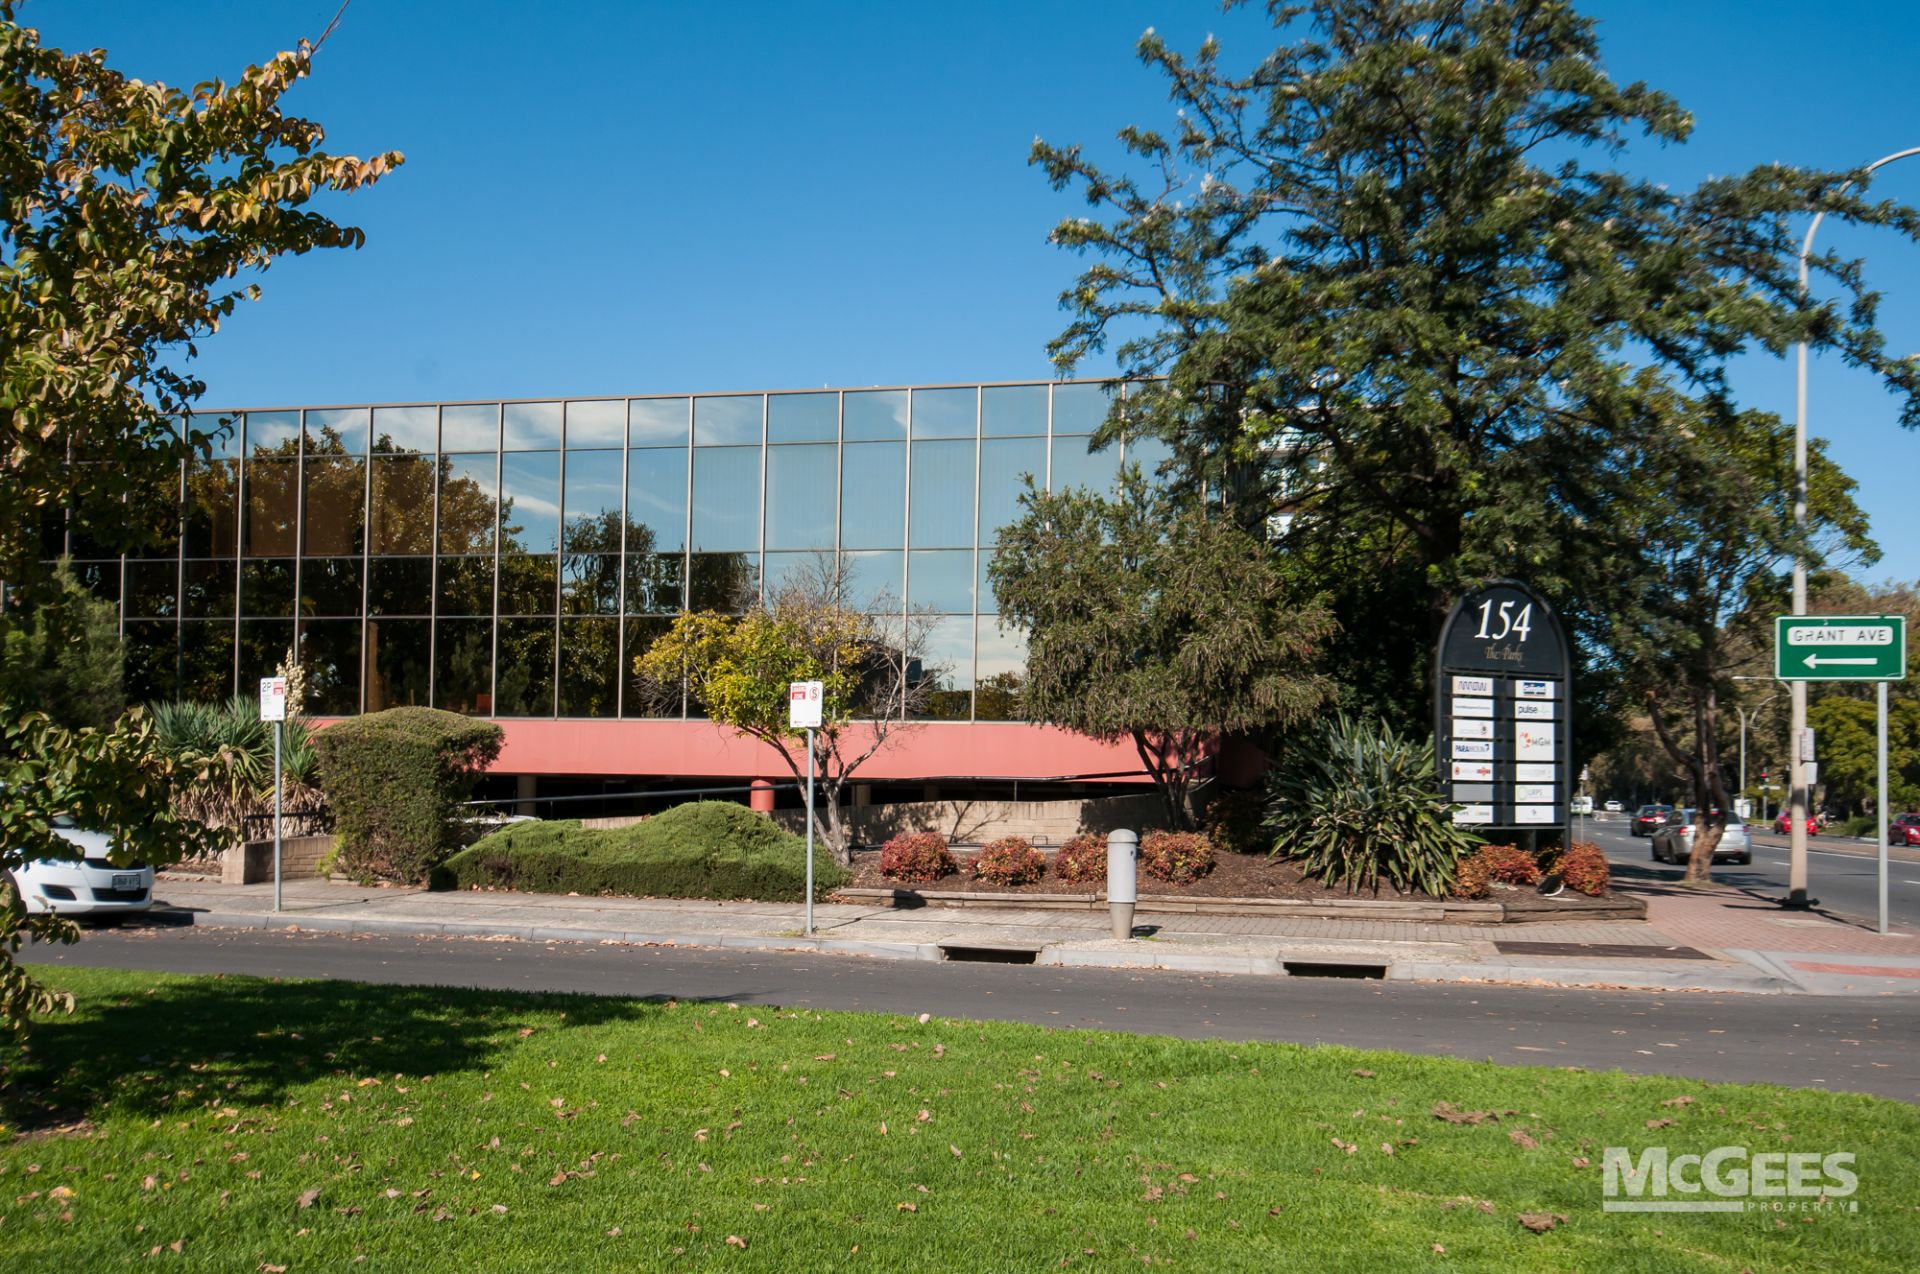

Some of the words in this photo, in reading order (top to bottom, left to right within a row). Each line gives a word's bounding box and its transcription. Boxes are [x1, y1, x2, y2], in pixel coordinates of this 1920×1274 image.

[1474, 599, 1532, 642] 154
[1794, 629, 1845, 642] GRANT
[1857, 629, 1887, 642] AVE
[262, 682, 272, 692] 2P
[1518, 706, 1538, 714] pulse
